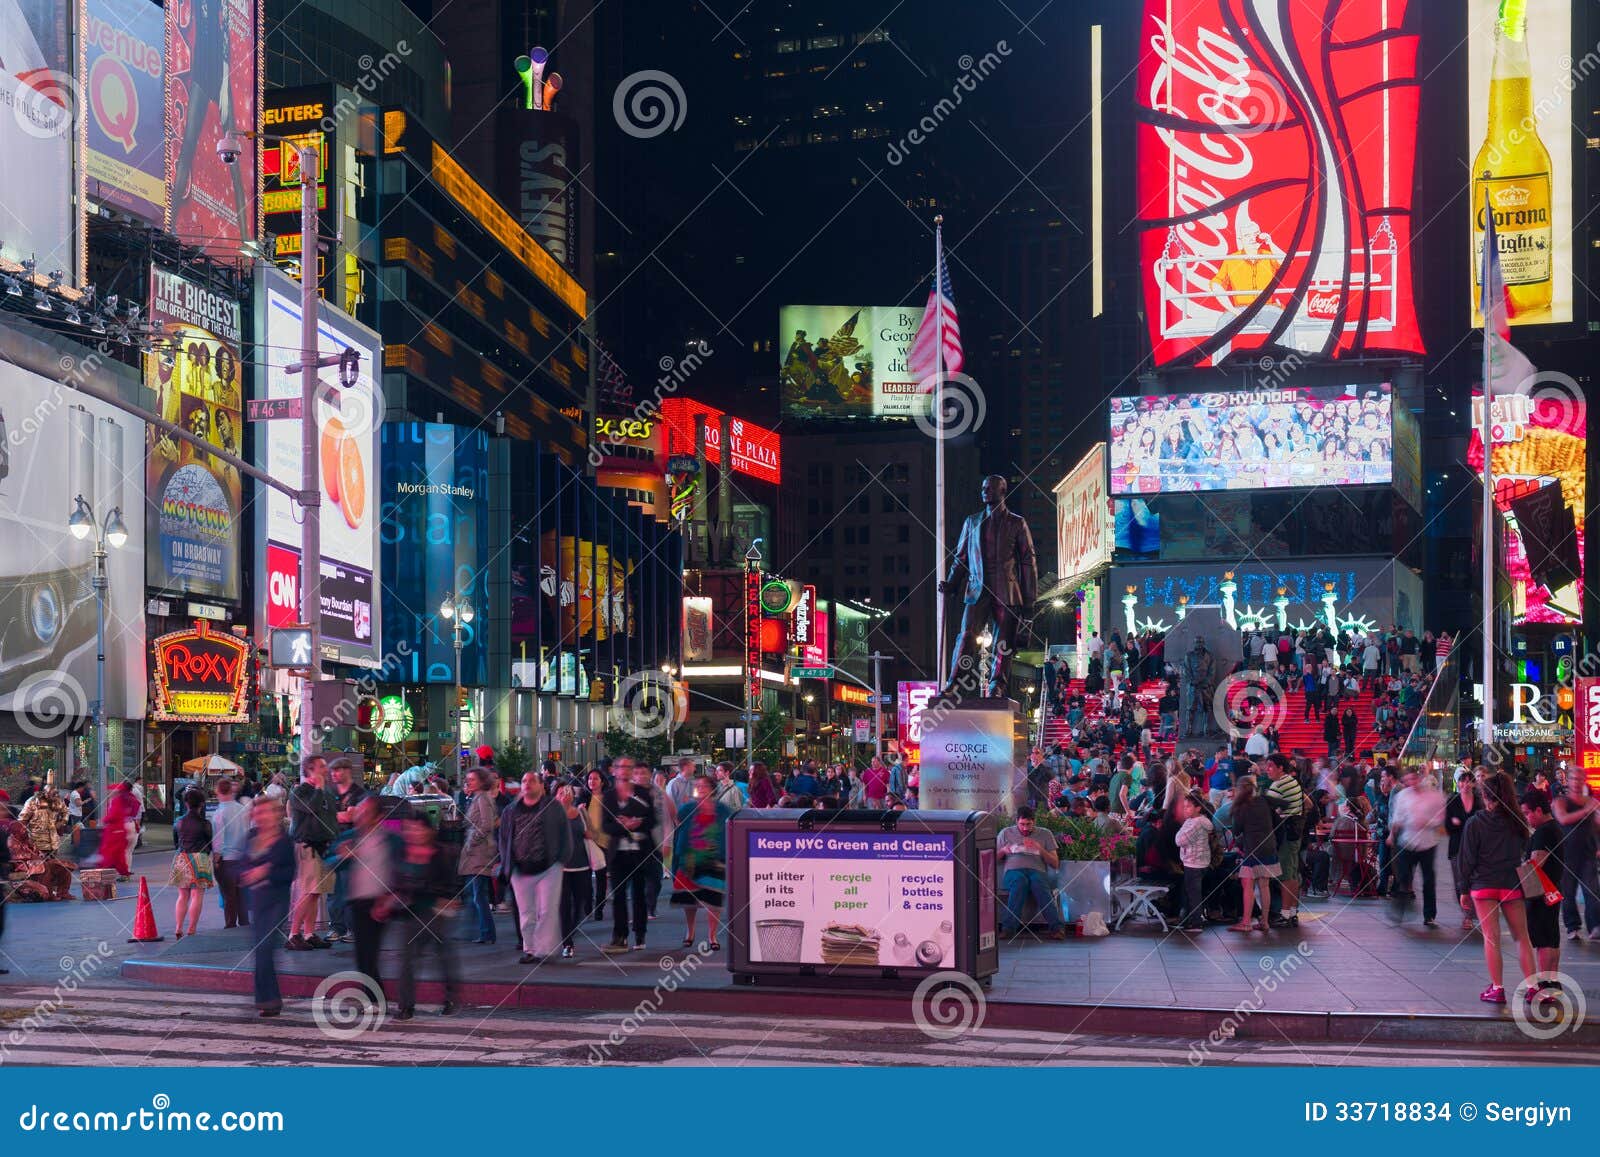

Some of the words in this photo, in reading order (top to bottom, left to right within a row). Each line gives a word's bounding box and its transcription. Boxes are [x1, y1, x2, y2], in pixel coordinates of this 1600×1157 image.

[89, 52, 139, 154] Q
[1477, 206, 1547, 231] Corona
[156, 270, 182, 306] THE
[185, 283, 239, 328] BIGGEST
[155, 297, 169, 313] BOX
[169, 303, 190, 322] OFFICE
[191, 312, 202, 326] HIT
[202, 316, 210, 331] OF
[211, 320, 222, 335] THE
[899, 314, 915, 329] By
[880, 329, 914, 342] Geor
[1229, 390, 1297, 406] HYUNDAI
[250, 406, 258, 418] W
[262, 404, 274, 417] 46
[746, 442, 777, 466] PLAZA
[731, 459, 749, 471] OTEL
[397, 482, 439, 496] Morgan
[440, 483, 475, 500] Stanley
[162, 497, 231, 530] MOTOWN
[172, 541, 183, 559] ON
[184, 543, 222, 565] BROADWAY
[270, 570, 296, 609] CNN
[177, 698, 227, 709] DELICATESSEN
[1508, 683, 1556, 724] R
[945, 743, 988, 754] GEORGE
[948, 761, 985, 771] COHAN
[757, 838, 792, 851] Keep
[796, 839, 824, 850] NYC
[827, 839, 868, 850] Green
[873, 840, 898, 851] and
[902, 840, 946, 852] Clean!
[754, 872, 773, 882] put
[777, 872, 805, 882] litter
[830, 873, 872, 883] recycle
[901, 874, 944, 885] recycle
[765, 885, 776, 894] in
[780, 885, 794, 894] its
[844, 886, 858, 895] all
[902, 887, 943, 897] bottles
[764, 898, 795, 909] place
[834, 900, 868, 910] paper
[903, 901, 911, 910] &
[915, 902, 943, 911] cans
